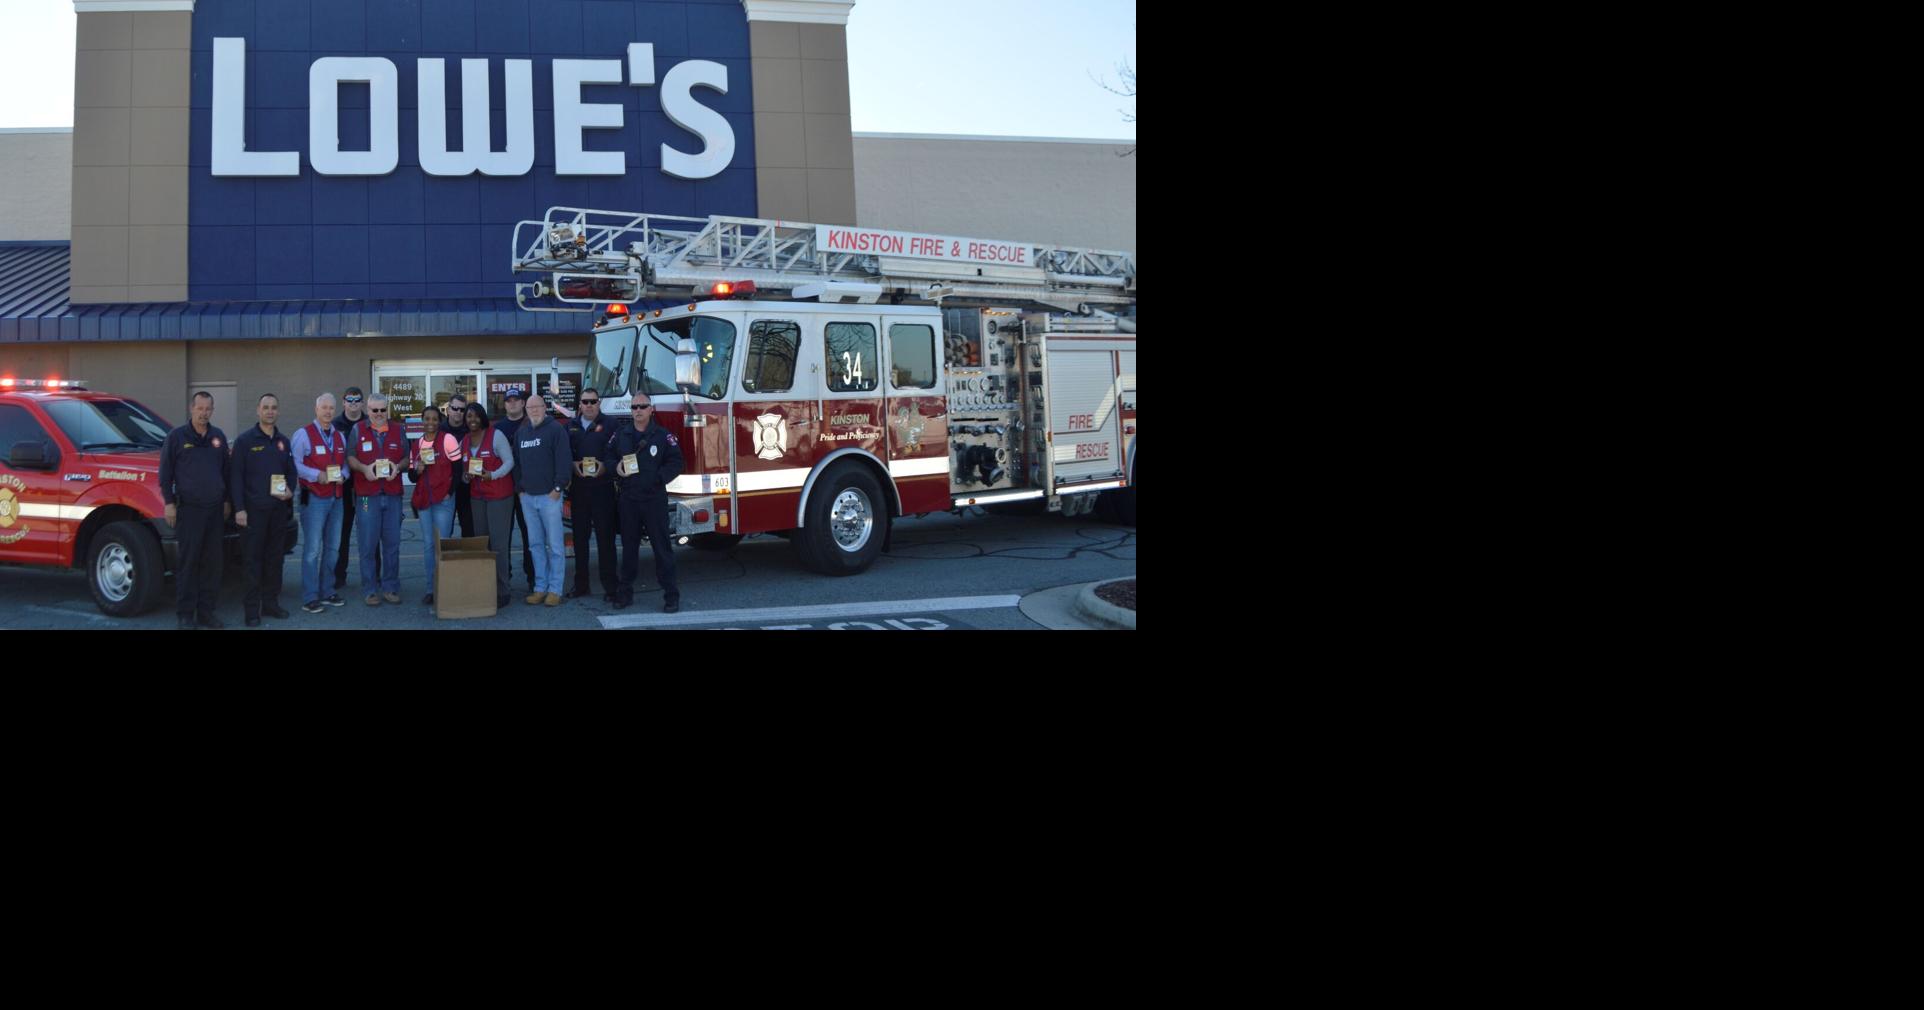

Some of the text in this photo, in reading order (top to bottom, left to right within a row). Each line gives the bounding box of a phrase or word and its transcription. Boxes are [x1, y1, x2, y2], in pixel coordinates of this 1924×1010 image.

[211, 37, 736, 179] LOWE'S
[827, 229, 1025, 264] KINSTON FIRE & RESCUE
[842, 351, 863, 386] 34
[491, 383, 526, 392] ENTER
[830, 413, 870, 426] KINSTON
[1067, 414, 1095, 430] FIRE
[820, 433, 836, 442] Pride
[836, 431, 848, 440] and
[1075, 442, 1110, 460] RESCUE
[98, 470, 147, 482] Battalion 1
[714, 477, 729, 487] 603
